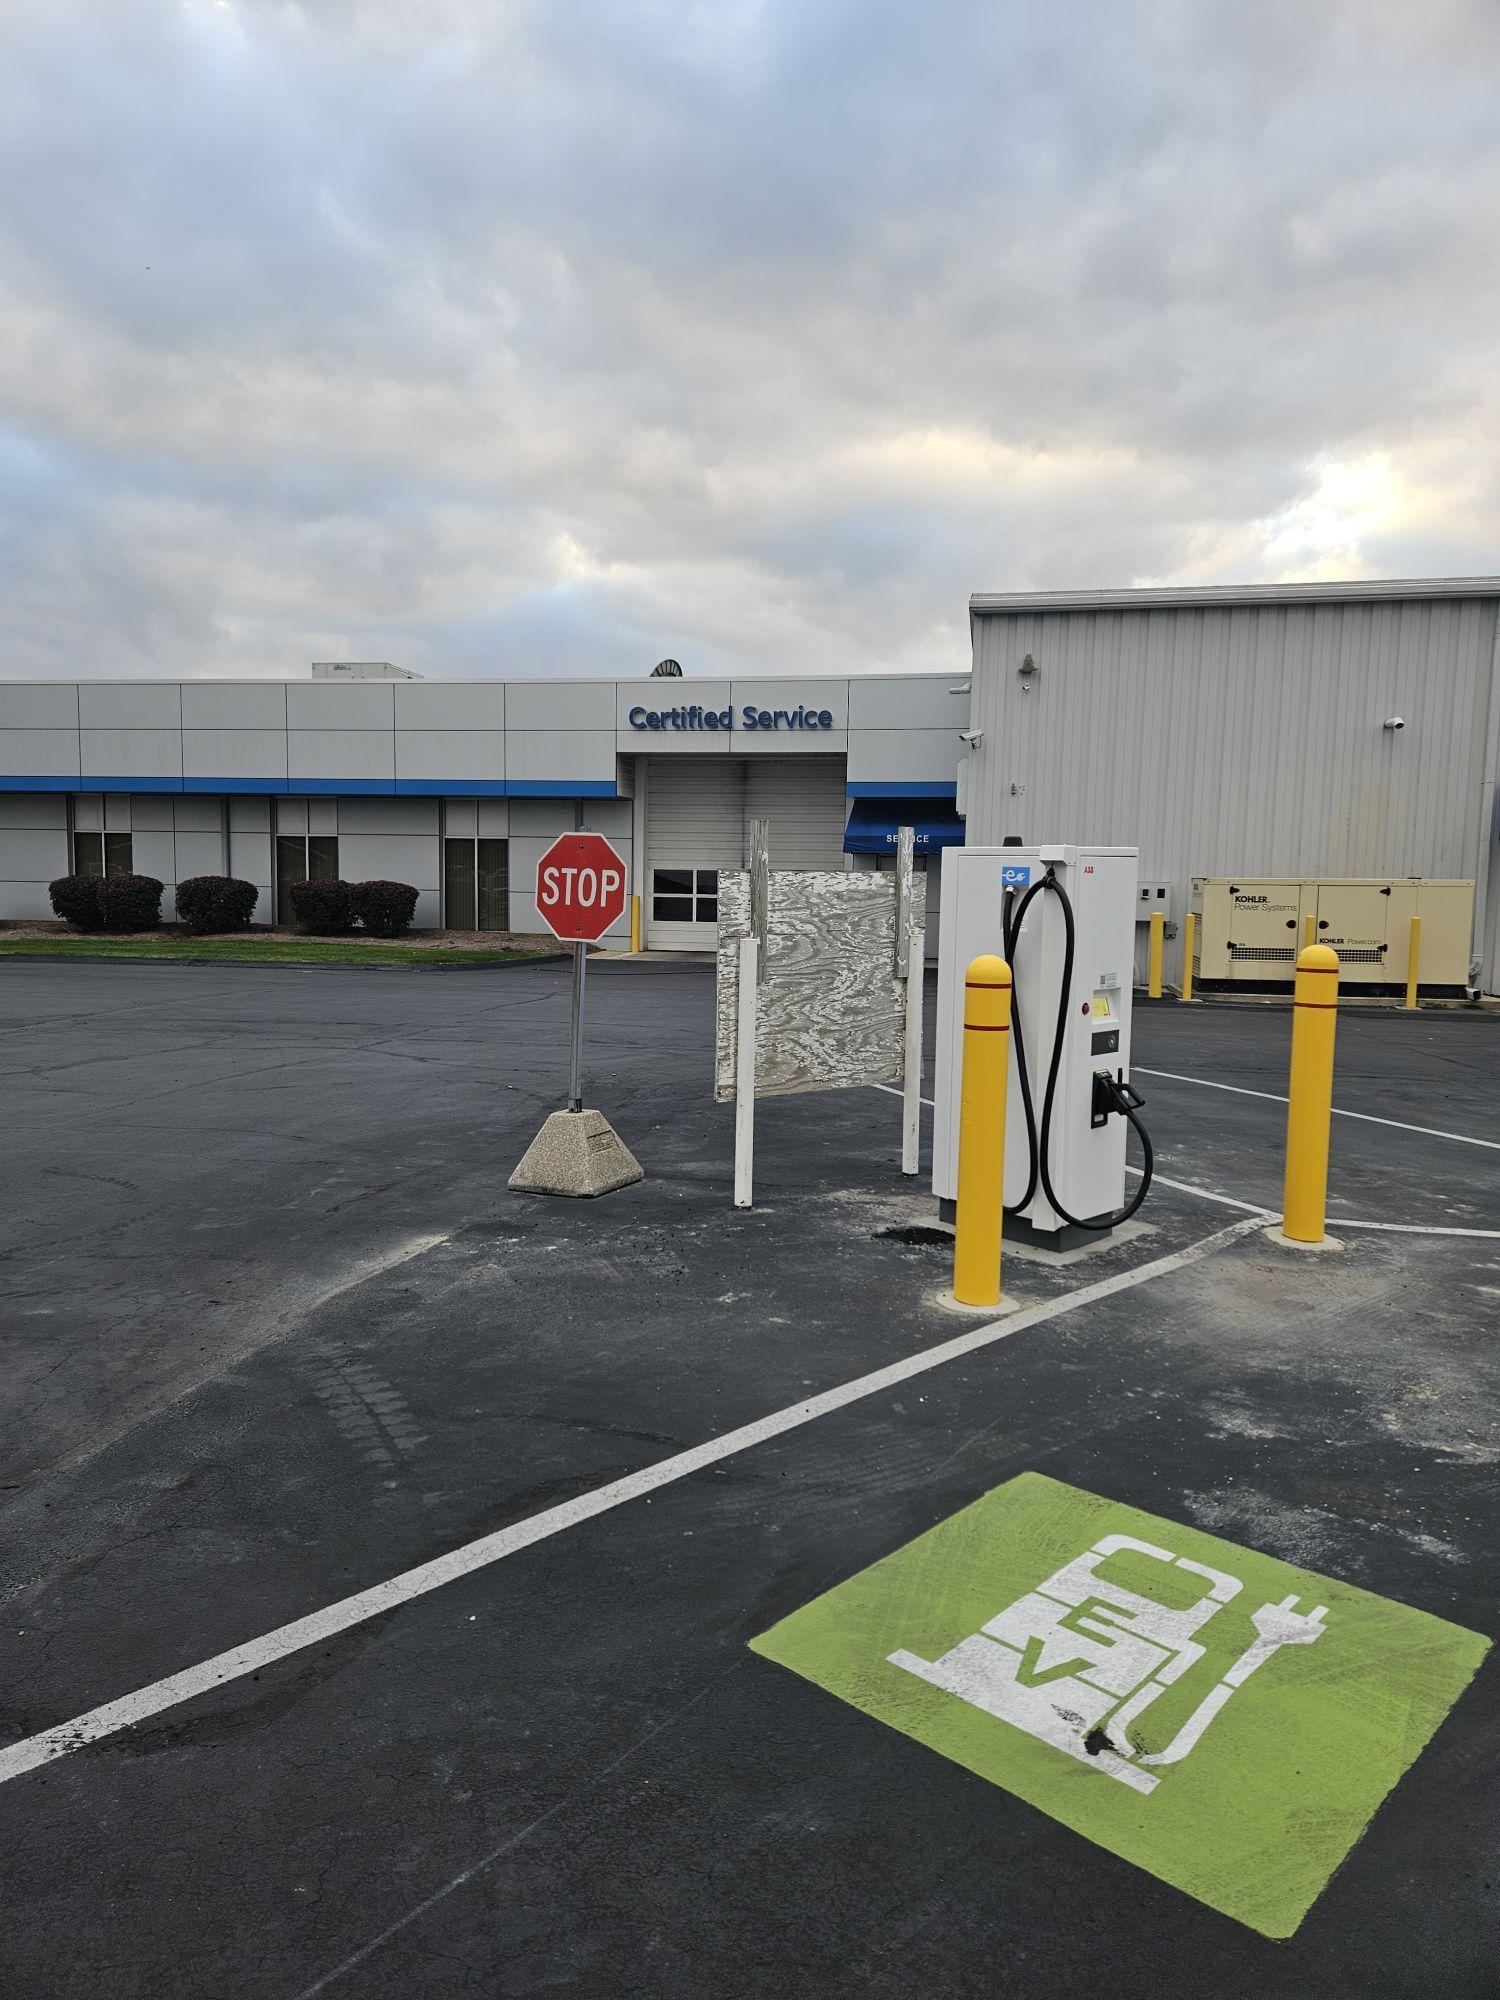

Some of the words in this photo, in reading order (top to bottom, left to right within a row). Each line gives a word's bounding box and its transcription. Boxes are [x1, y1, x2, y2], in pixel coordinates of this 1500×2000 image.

[629, 706, 733, 729] Certified
[742, 706, 833, 729] Service
[886, 834, 930, 843] SEICE
[541, 866, 620, 908] STOP
[1235, 895, 1269, 903] KOHLER
[1234, 903, 1260, 911] Power
[1261, 903, 1298, 912] Systems
